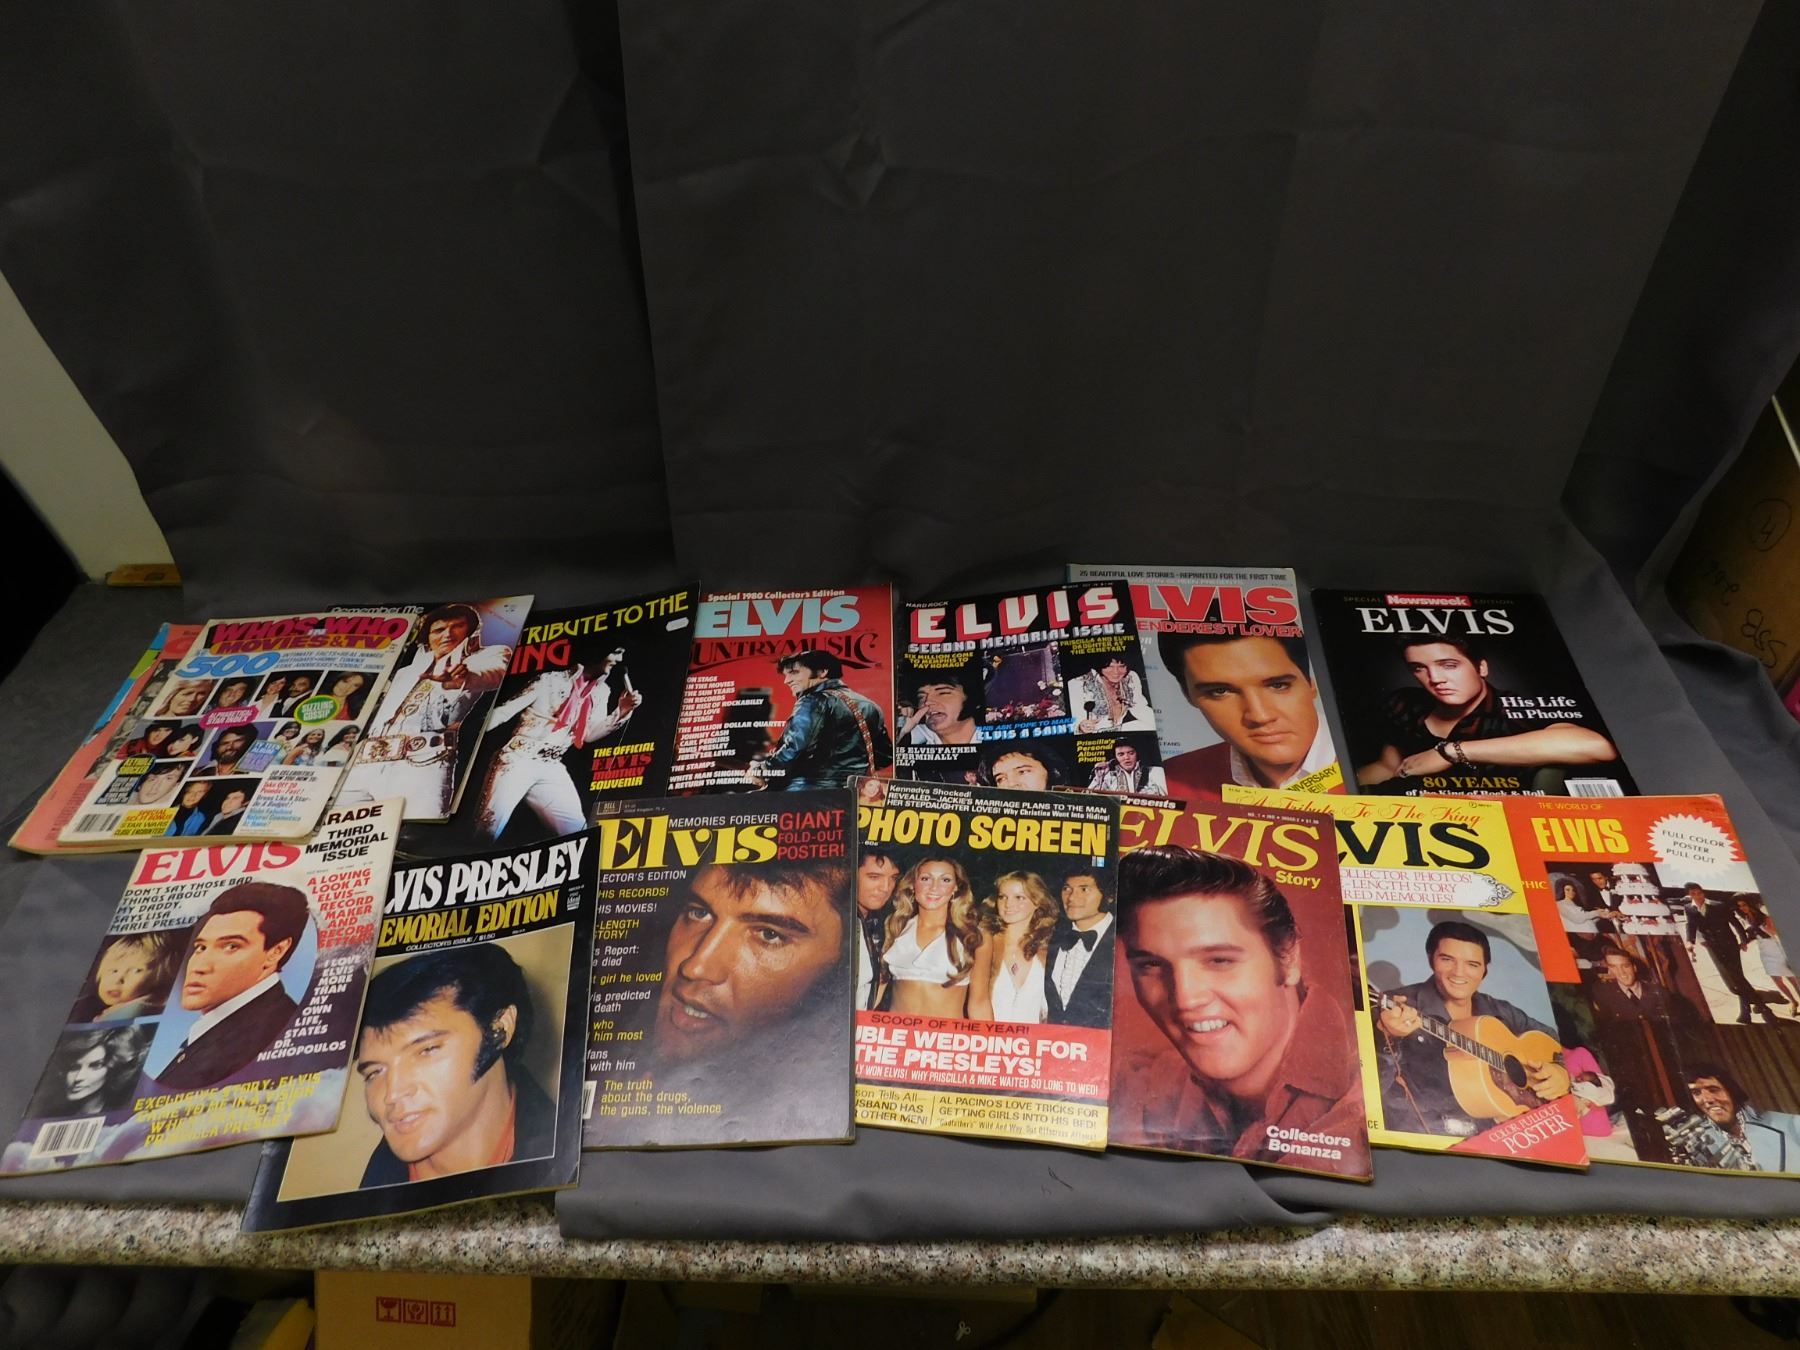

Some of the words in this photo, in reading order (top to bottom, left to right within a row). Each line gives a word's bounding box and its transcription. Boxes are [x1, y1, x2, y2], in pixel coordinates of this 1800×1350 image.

[708, 593, 741, 602] Special
[743, 592, 763, 600] 1980
[812, 588, 845, 597] Edition
[1387, 594, 1468, 606] Newsweek
[613, 604, 644, 628] TO
[646, 590, 690, 620] THE
[910, 587, 1121, 643] ELVIS
[693, 595, 861, 639] ELVIS
[1355, 607, 1515, 635] ELVIS
[212, 616, 317, 644] WHO'S
[322, 616, 410, 640] WHO
[1239, 624, 1302, 638] LOVER
[908, 640, 977, 654] SECOND
[979, 630, 1069, 649] MEMORIAL
[1072, 623, 1125, 637] ISSUE
[175, 652, 281, 678] 500
[722, 698, 764, 708] ROCKABILLY
[1499, 696, 1536, 708] His
[1538, 696, 1577, 708] Life
[1506, 709, 1522, 719] in
[1523, 709, 1583, 720] Photos
[692, 724, 722, 732] MILLION
[724, 721, 752, 729] DOLLAR
[1031, 723, 1076, 737] SAINT
[614, 742, 655, 755] OFFICIAL
[712, 749, 736, 758] LEWIS
[1077, 744, 1114, 752] Personal
[896, 754, 959, 762] TERMINALLY
[1078, 756, 1107, 764] Photos
[686, 762, 716, 770] STAMPS
[714, 770, 746, 778] SINGING
[590, 776, 644, 792] SOUVENIR
[1422, 777, 1447, 789] 80
[1451, 776, 1520, 789] YEARS
[889, 784, 930, 795] Kennedys
[932, 788, 972, 798] Shocked!
[904, 802, 970, 813] STEPDAUGHTER
[971, 805, 1002, 814] LOVES!
[974, 799, 1021, 809] MARRIAGE
[1022, 802, 1051, 811] PLANS
[1119, 796, 1177, 809] Presents
[668, 815, 726, 828] MEMORIES
[730, 814, 778, 826] FOREVER
[780, 810, 845, 831] GIANT
[1432, 806, 1482, 828] King
[327, 822, 376, 840] THIRD
[778, 830, 845, 844] FOLD-OUT
[859, 807, 962, 848] PHOTO
[968, 815, 1107, 857] SCREEN
[1530, 817, 1630, 854] ELVIS
[304, 830, 390, 855] MEMORIAL
[596, 814, 778, 870] Elvis
[1119, 805, 1320, 872] ELVIS
[1337, 820, 1490, 870] VIS
[1662, 829, 1684, 841] FULL
[1688, 834, 1726, 848] COLOR
[777, 844, 846, 861] POSTER!
[1666, 848, 1688, 860] PULL
[1672, 840, 1710, 854] POSTER
[321, 845, 370, 864] ISSUE
[133, 841, 302, 886] ELVIS
[320, 868, 371, 885] LOVING
[384, 864, 444, 915] VIS
[444, 836, 589, 911] PRESLEY
[600, 871, 645, 884] ECTOR'S
[648, 869, 688, 882] EDITION
[1276, 870, 1322, 890] Story
[1413, 870, 1472, 884] PHOTOS!
[187, 880, 227, 890] THOSE
[312, 882, 349, 894] LOOK
[1412, 882, 1458, 893] STORY
[122, 895, 167, 906] THINGS
[168, 890, 208, 900] ABOUT
[618, 887, 669, 898] RECORDS!
[1374, 891, 1455, 904] MEMORIES!
[320, 895, 374, 912] RECORD
[615, 903, 658, 914] MOVIES!
[146, 910, 170, 920] LISA
[324, 902, 372, 920] MAKER
[475, 888, 560, 935] EDITION
[111, 920, 148, 932] MARIE
[327, 917, 358, 928] AND
[604, 945, 640, 959] Report:
[602, 957, 622, 967] died
[322, 964, 355, 977] ELVIS
[318, 973, 353, 986] MORE
[600, 974, 616, 986] girl
[636, 972, 662, 982] loved
[314, 984, 348, 997] THAN
[604, 990, 651, 1003] predicted
[302, 1004, 333, 1016] OWN
[594, 1003, 622, 1013] death
[871, 1013, 923, 1027] SCOOP
[928, 1019, 946, 1030] OF
[952, 1021, 981, 1032] THE
[984, 1022, 1030, 1035] YEAR!
[284, 1024, 329, 1039] STATES
[616, 1030, 644, 1041] most
[256, 1040, 347, 1063] NICHOPOULOS
[914, 1031, 1031, 1058] WEDDING
[1036, 1040, 1089, 1062] FOR
[587, 1049, 608, 1060] fans
[855, 1044, 900, 1065] THE
[904, 1050, 1042, 1077] PRESLEYS!
[590, 1060, 612, 1072] with
[627, 1080, 653, 1090] truth
[883, 1067, 908, 1079] ELVIS!
[928, 1072, 968, 1084] PRISCILLA
[977, 1075, 998, 1086] MIKE
[1000, 1076, 1030, 1089] WAITED
[1044, 1080, 1064, 1091] LONG
[602, 1092, 632, 1104] about
[656, 1090, 692, 1104] drugs,
[878, 1090, 900, 1102] Tells
[600, 1105, 617, 1116] the
[621, 1106, 651, 1118] guns,
[678, 1104, 722, 1114] violence
[956, 1096, 1004, 1110] PACINO'S
[1005, 1100, 1033, 1112] LOVE
[1035, 1104, 1075, 1116] TRICKS
[860, 1110, 897, 1122] OTHER
[900, 1114, 928, 1126] MEN!
[939, 1108, 986, 1120] GETTING
[988, 1110, 1020, 1122] GIRLS
[1022, 1113, 1049, 1124] INTO
[1488, 1123, 1520, 1142] COLOR
[1519, 1104, 1560, 1128] PULLOUT
[1266, 1125, 1352, 1148] Collectors
[1502, 1113, 1574, 1154] POSTER
[1268, 1138, 1342, 1160] Bonanza
